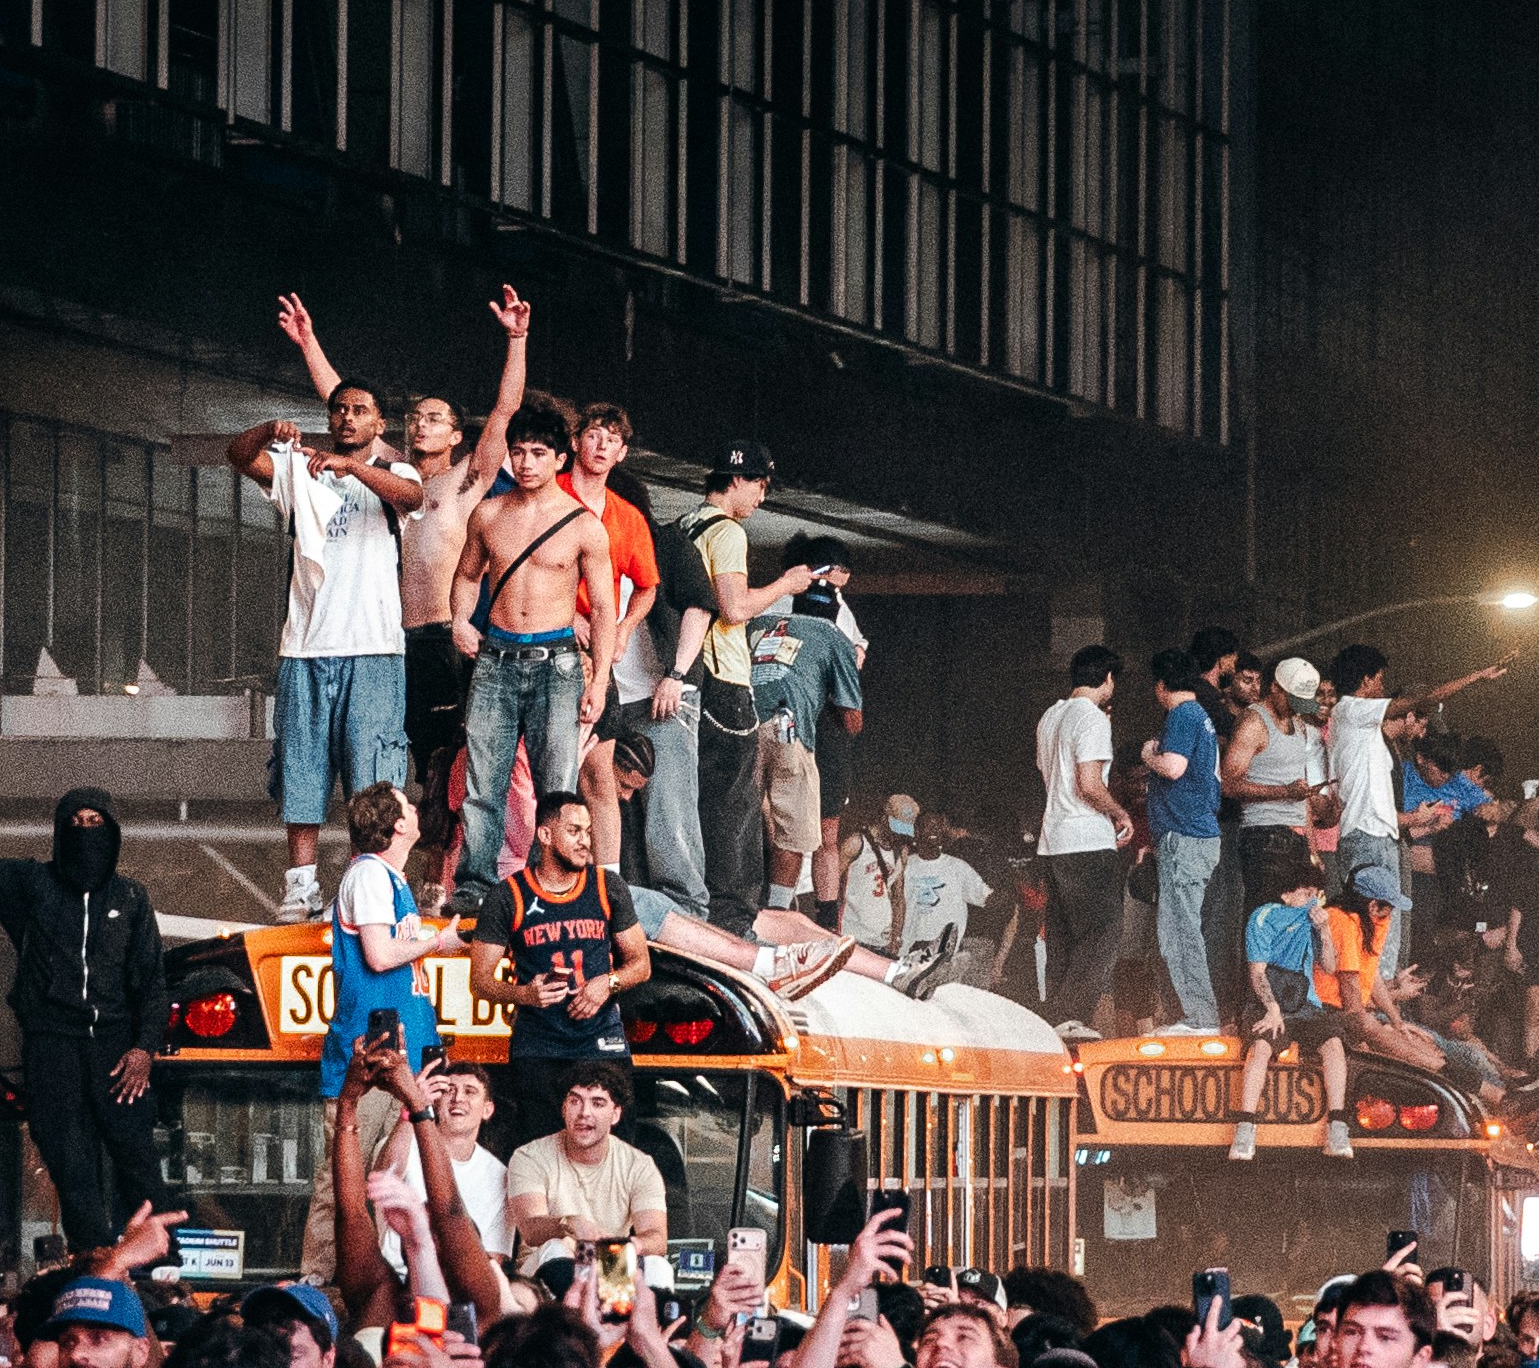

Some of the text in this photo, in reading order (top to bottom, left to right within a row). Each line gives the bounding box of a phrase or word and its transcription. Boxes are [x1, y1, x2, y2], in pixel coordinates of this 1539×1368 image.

[523, 919, 606, 947] NEW YORK
[1112, 1069, 1246, 1119] SCHOOL
